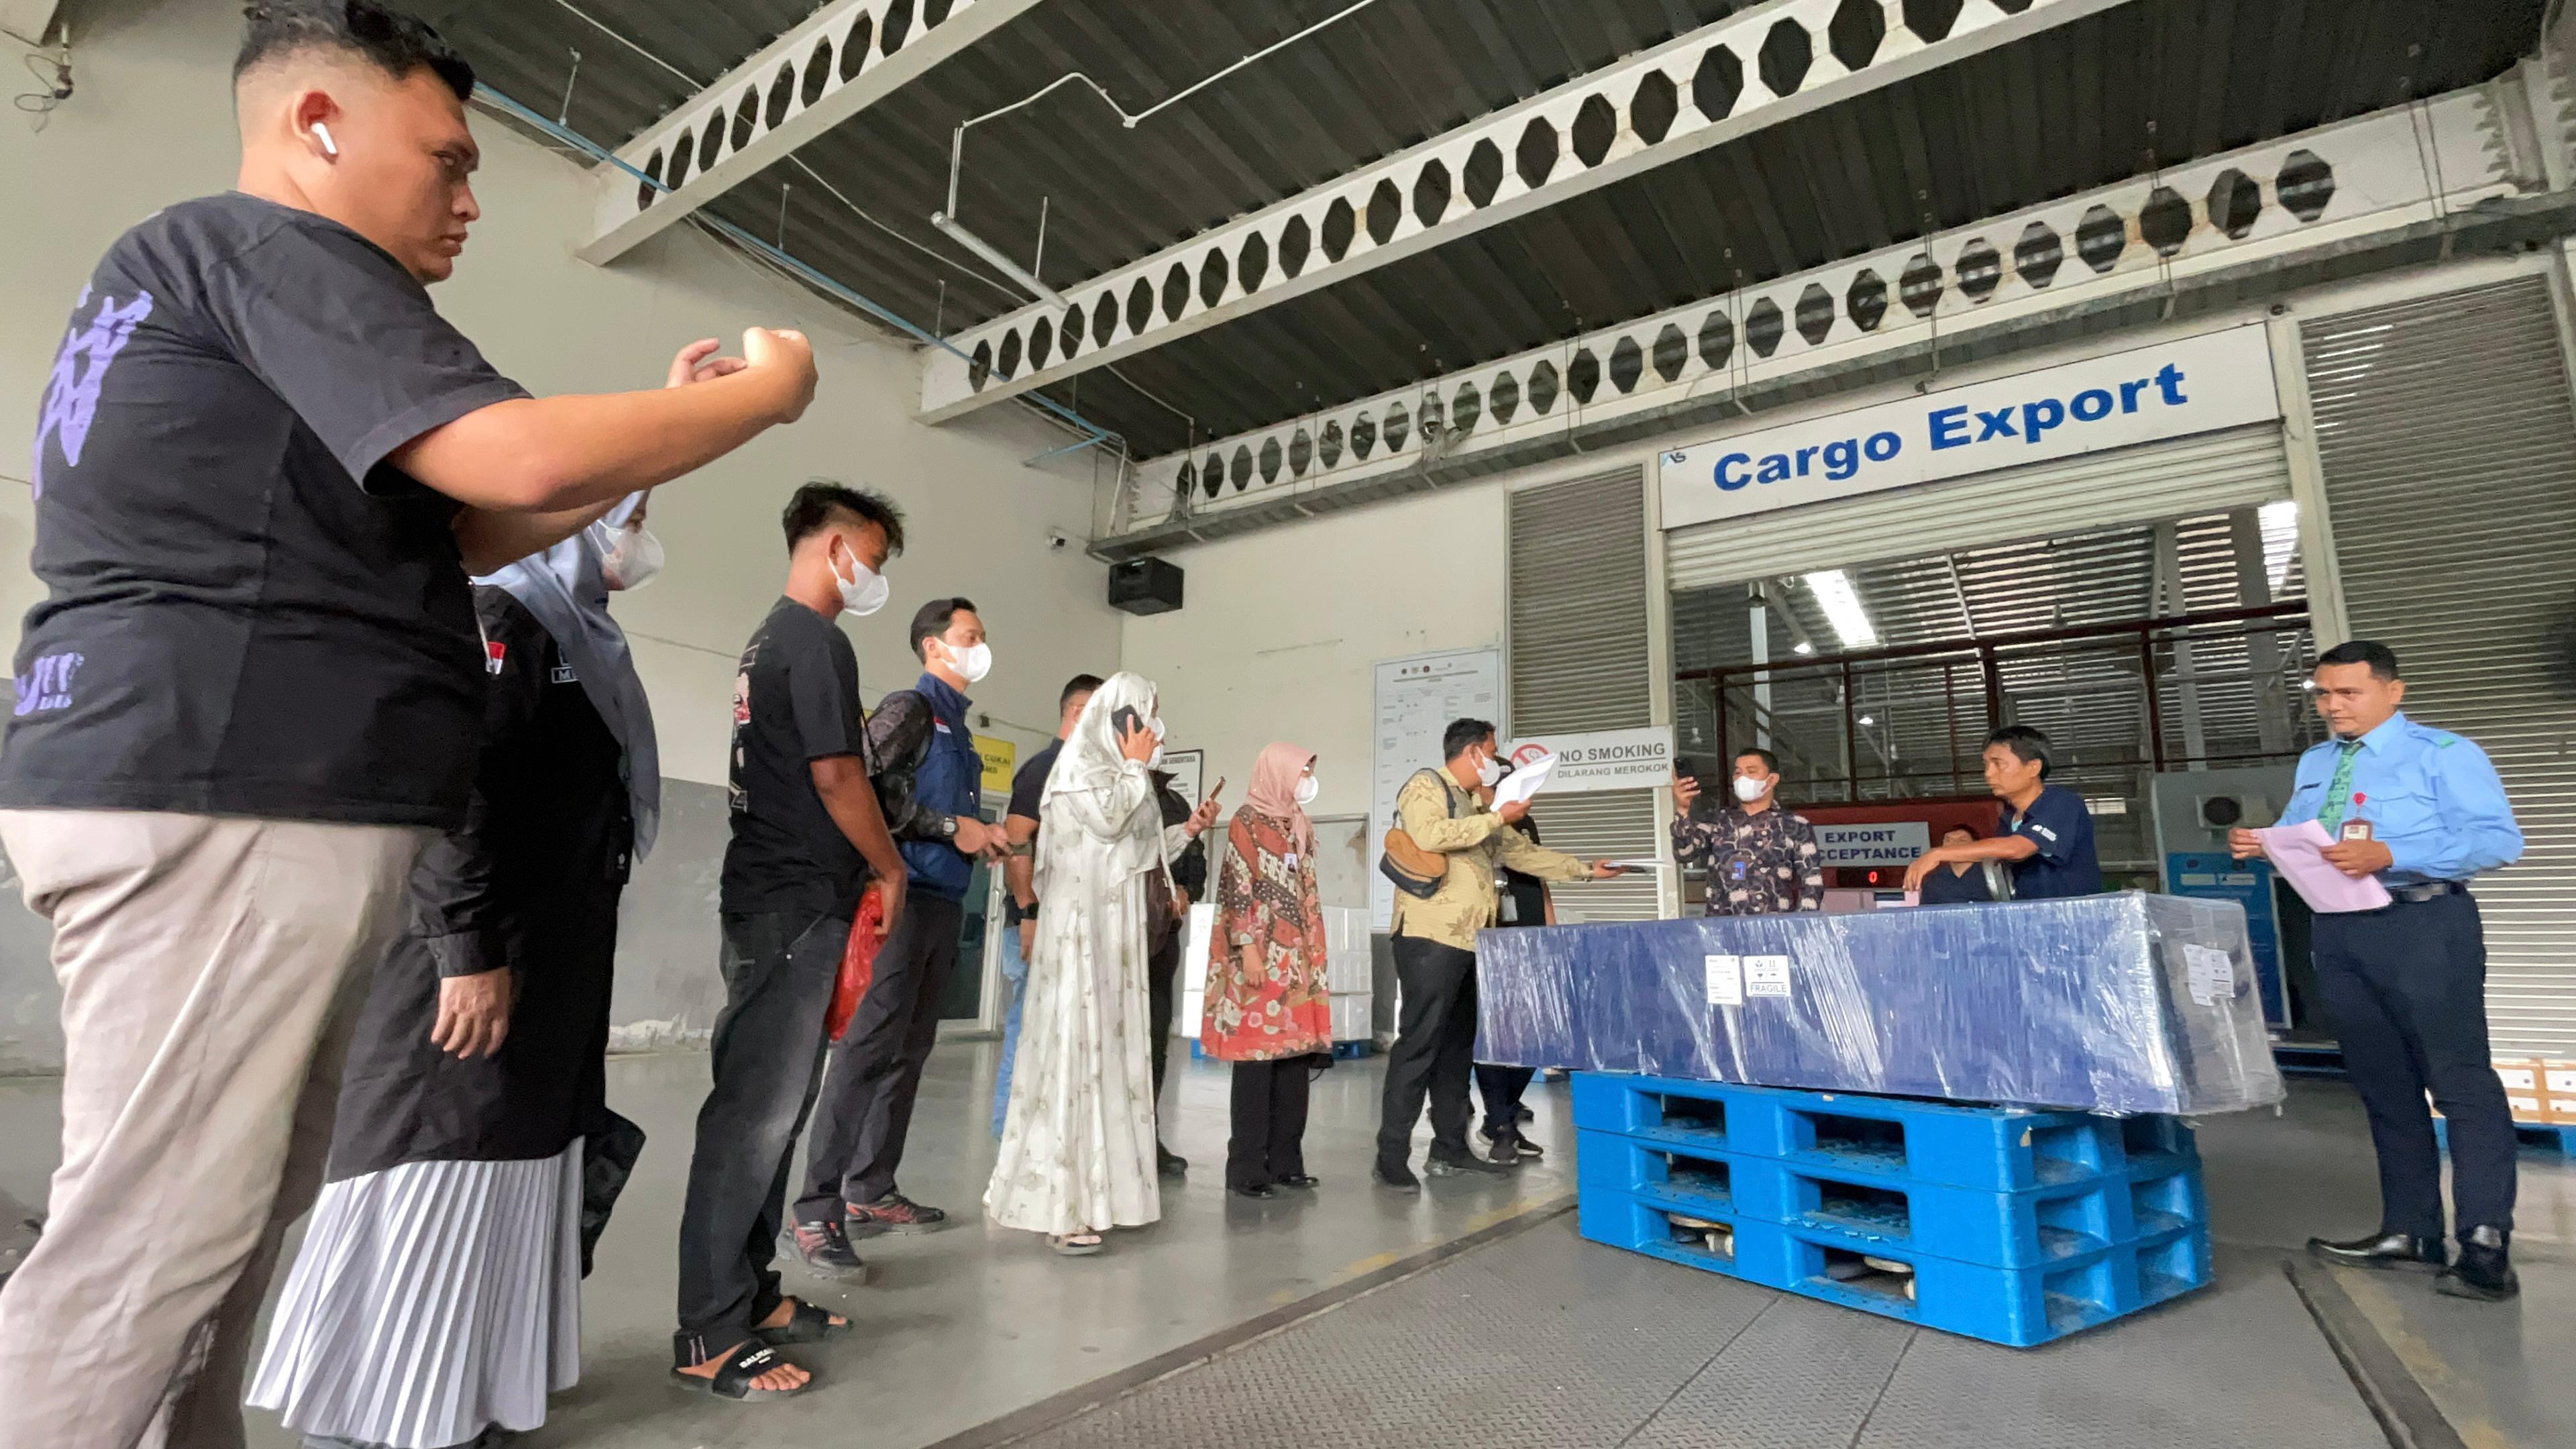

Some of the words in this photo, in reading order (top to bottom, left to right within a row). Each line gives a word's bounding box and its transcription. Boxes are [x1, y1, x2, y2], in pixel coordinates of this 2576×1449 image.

[1713, 431, 1902, 491] Cargo
[1928, 362, 2188, 451] Export
[1560, 749, 1582, 762] NO
[1588, 743, 1665, 760] SMOKING
[1558, 767, 1611, 778] DILARANG
[1614, 763, 1668, 774] MEROKOK
[1825, 830, 1896, 843] EXPORT
[1815, 845, 1922, 860] CCEPTANCE
[1868, 871, 1878, 883] 0
[1750, 984, 1787, 993] FRAGILE
